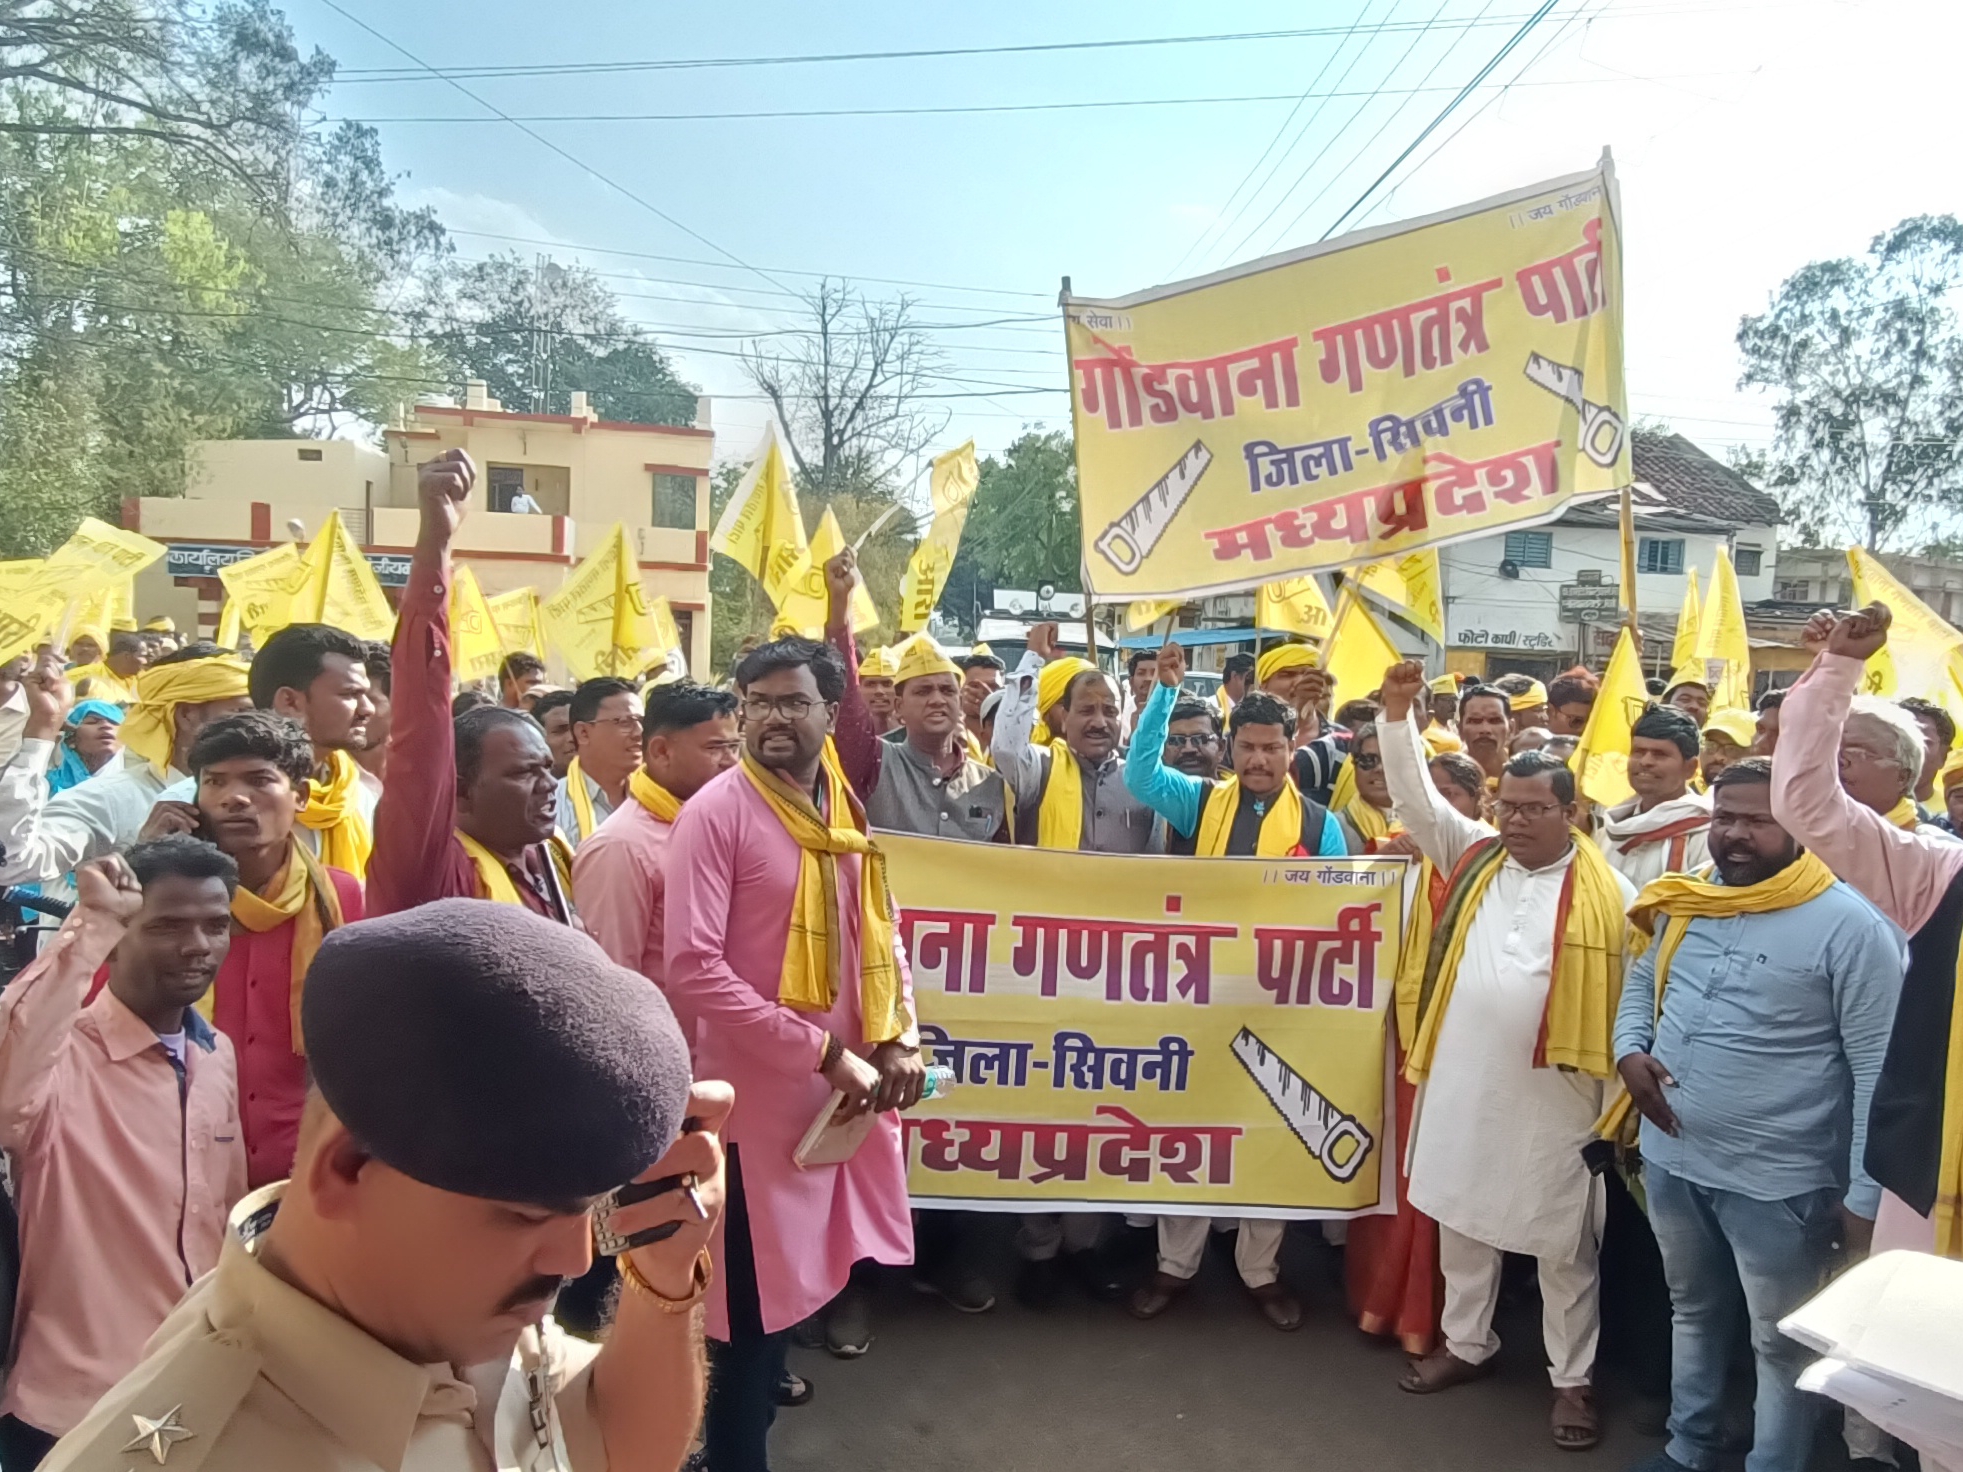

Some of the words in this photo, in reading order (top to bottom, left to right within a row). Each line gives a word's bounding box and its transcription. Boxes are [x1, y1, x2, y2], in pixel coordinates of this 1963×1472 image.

[1527, 204, 1553, 221] जय
[1074, 335, 1301, 430] गोंडवाना
[1312, 266, 1504, 394] गणतंत्र
[1086, 310, 1113, 329] सेवा
[1243, 377, 1496, 493] जिला-सिवनी
[1204, 439, 1562, 561] मध्यप्रदेश
[1458, 629, 1489, 645] फोटो
[1285, 869, 1311, 883] जय
[1317, 866, 1376, 885] गोंडवाना
[1011, 895, 1238, 1004] गणतंत्र
[1254, 902, 1383, 1009] पार्टी
[902, 1106, 1243, 1184] ध्यप्रदेश
